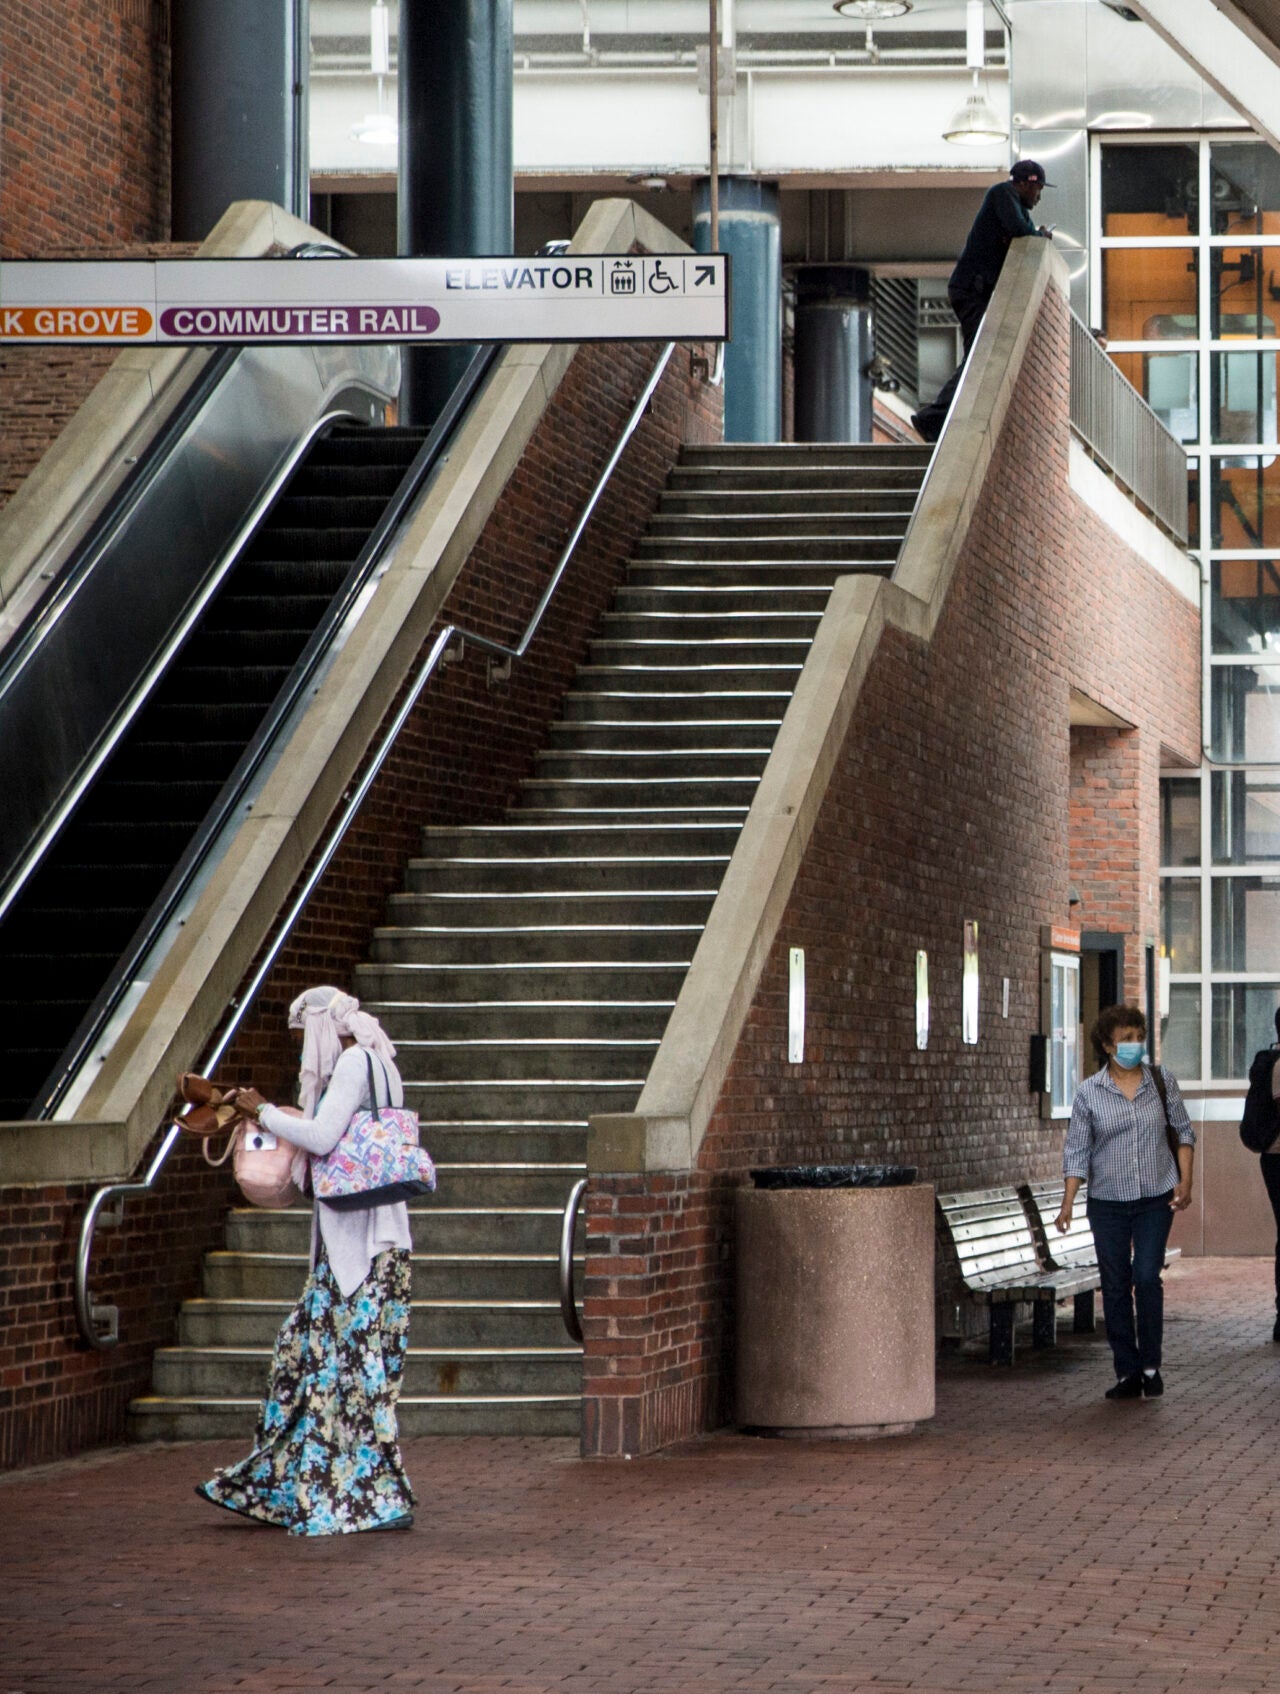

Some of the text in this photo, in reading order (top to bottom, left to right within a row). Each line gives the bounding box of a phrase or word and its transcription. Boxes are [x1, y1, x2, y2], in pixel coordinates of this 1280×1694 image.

[445, 266, 593, 290] ELEVATOR
[0, 310, 139, 334] K GROVE
[173, 308, 427, 334] COMMUTER RAIL
